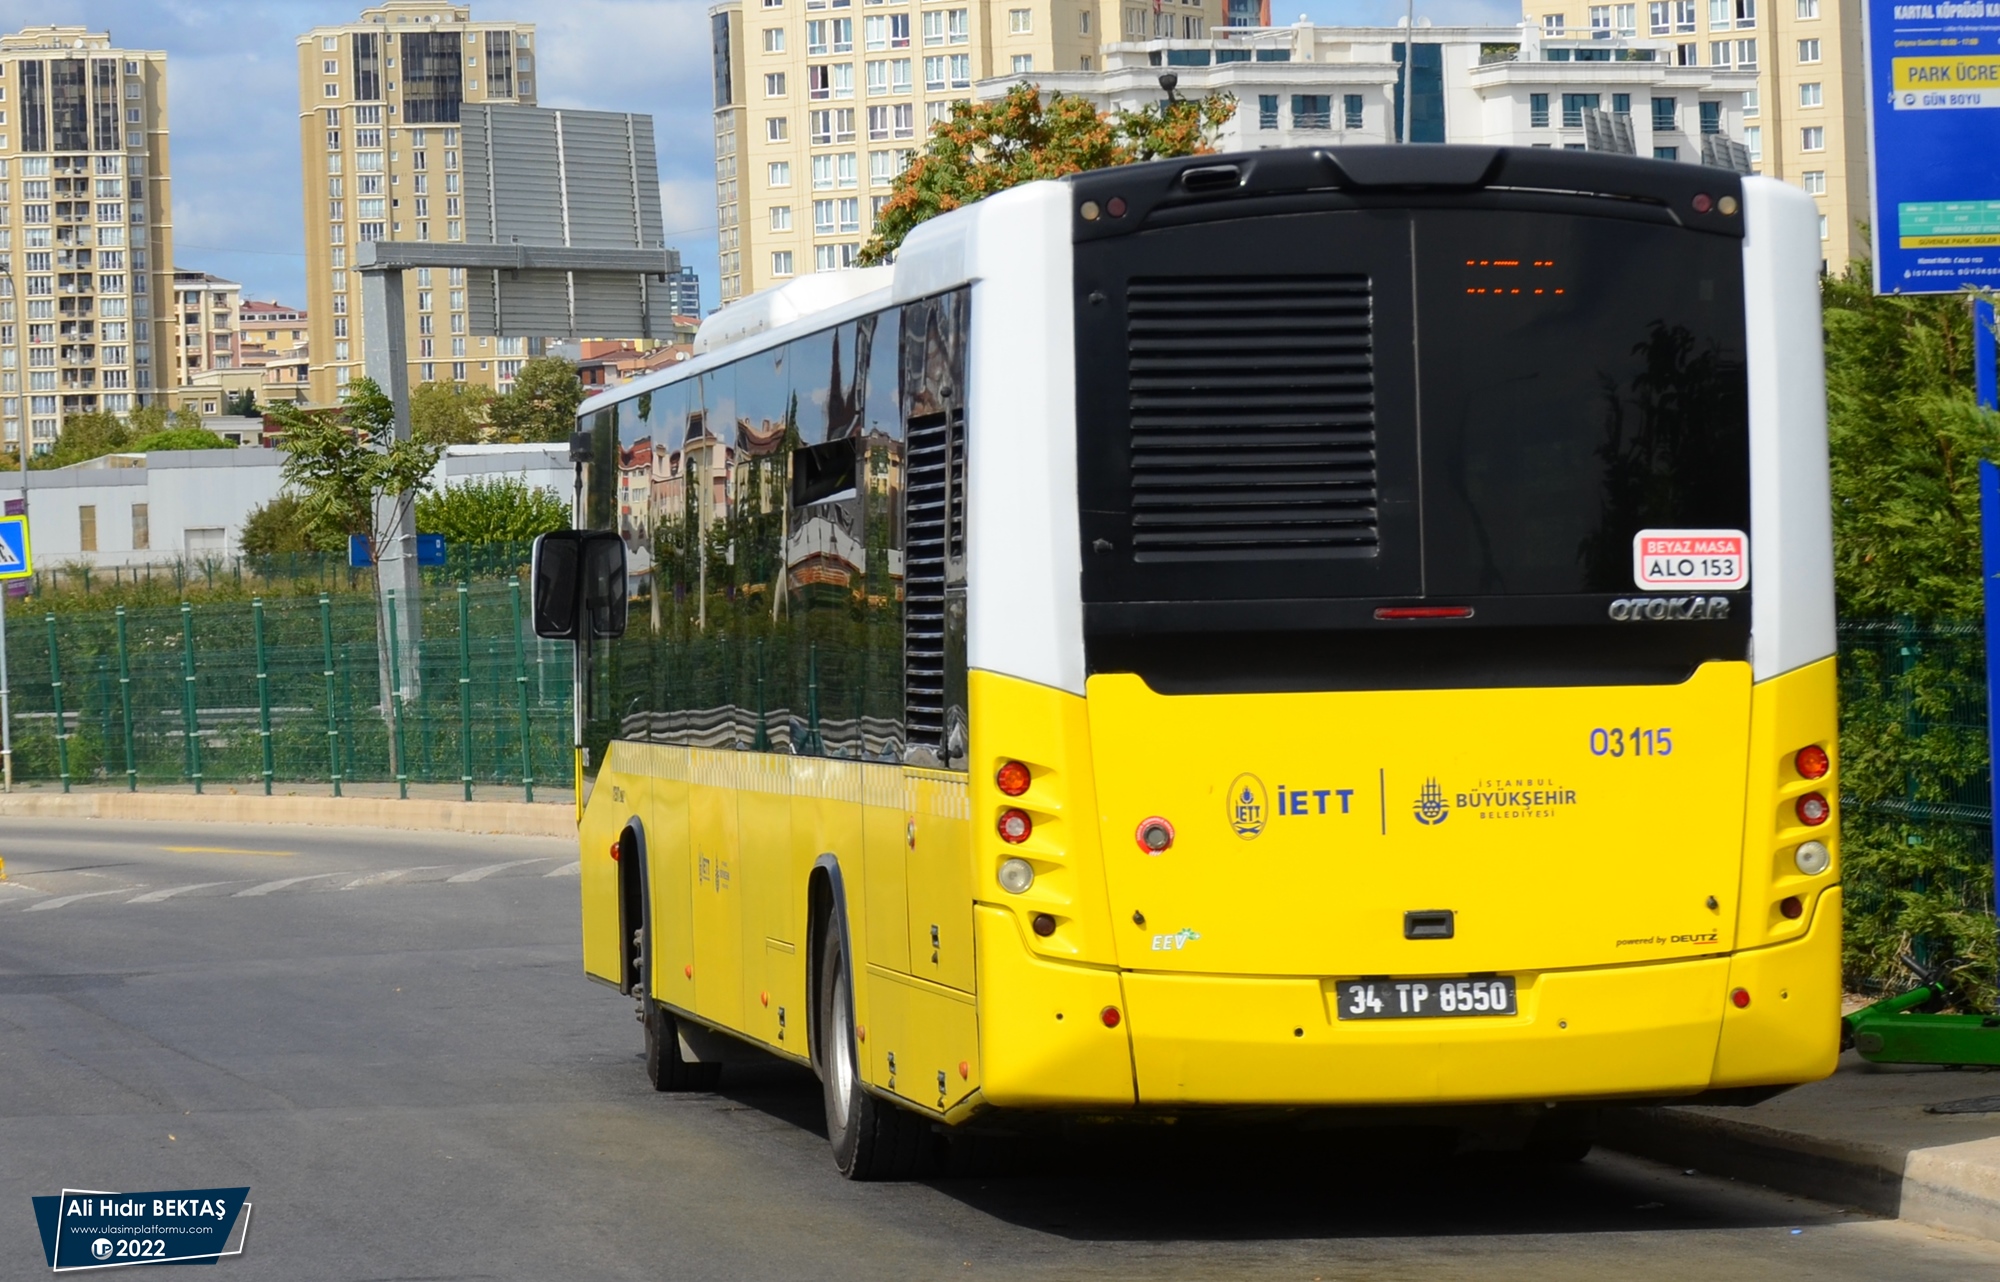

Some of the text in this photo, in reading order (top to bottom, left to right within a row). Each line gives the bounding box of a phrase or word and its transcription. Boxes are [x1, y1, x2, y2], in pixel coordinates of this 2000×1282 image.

[1894, 4, 1935, 20] KARTAL
[1936, 1, 1985, 19] KÖPRÜSÜ
[1908, 66, 1951, 82] PARK
[1923, 92, 1981, 106] GÜN BOYU
[1647, 540, 1736, 553] BEYAZ MASA
[1649, 559, 1734, 577] ALO 153
[1608, 596, 1731, 621] OTOKAR
[1479, 778, 1554, 788] İSTANBUL
[1278, 785, 1354, 816] İETT
[1456, 786, 1577, 810] BÜYÜKŞEHİR
[1480, 809, 1555, 819] BELEDİYESİ
[1151, 935, 1187, 951] EEV
[1616, 934, 1718, 948] powered by DEUTZ
[1349, 982, 1507, 1014] 34 TP 8550
